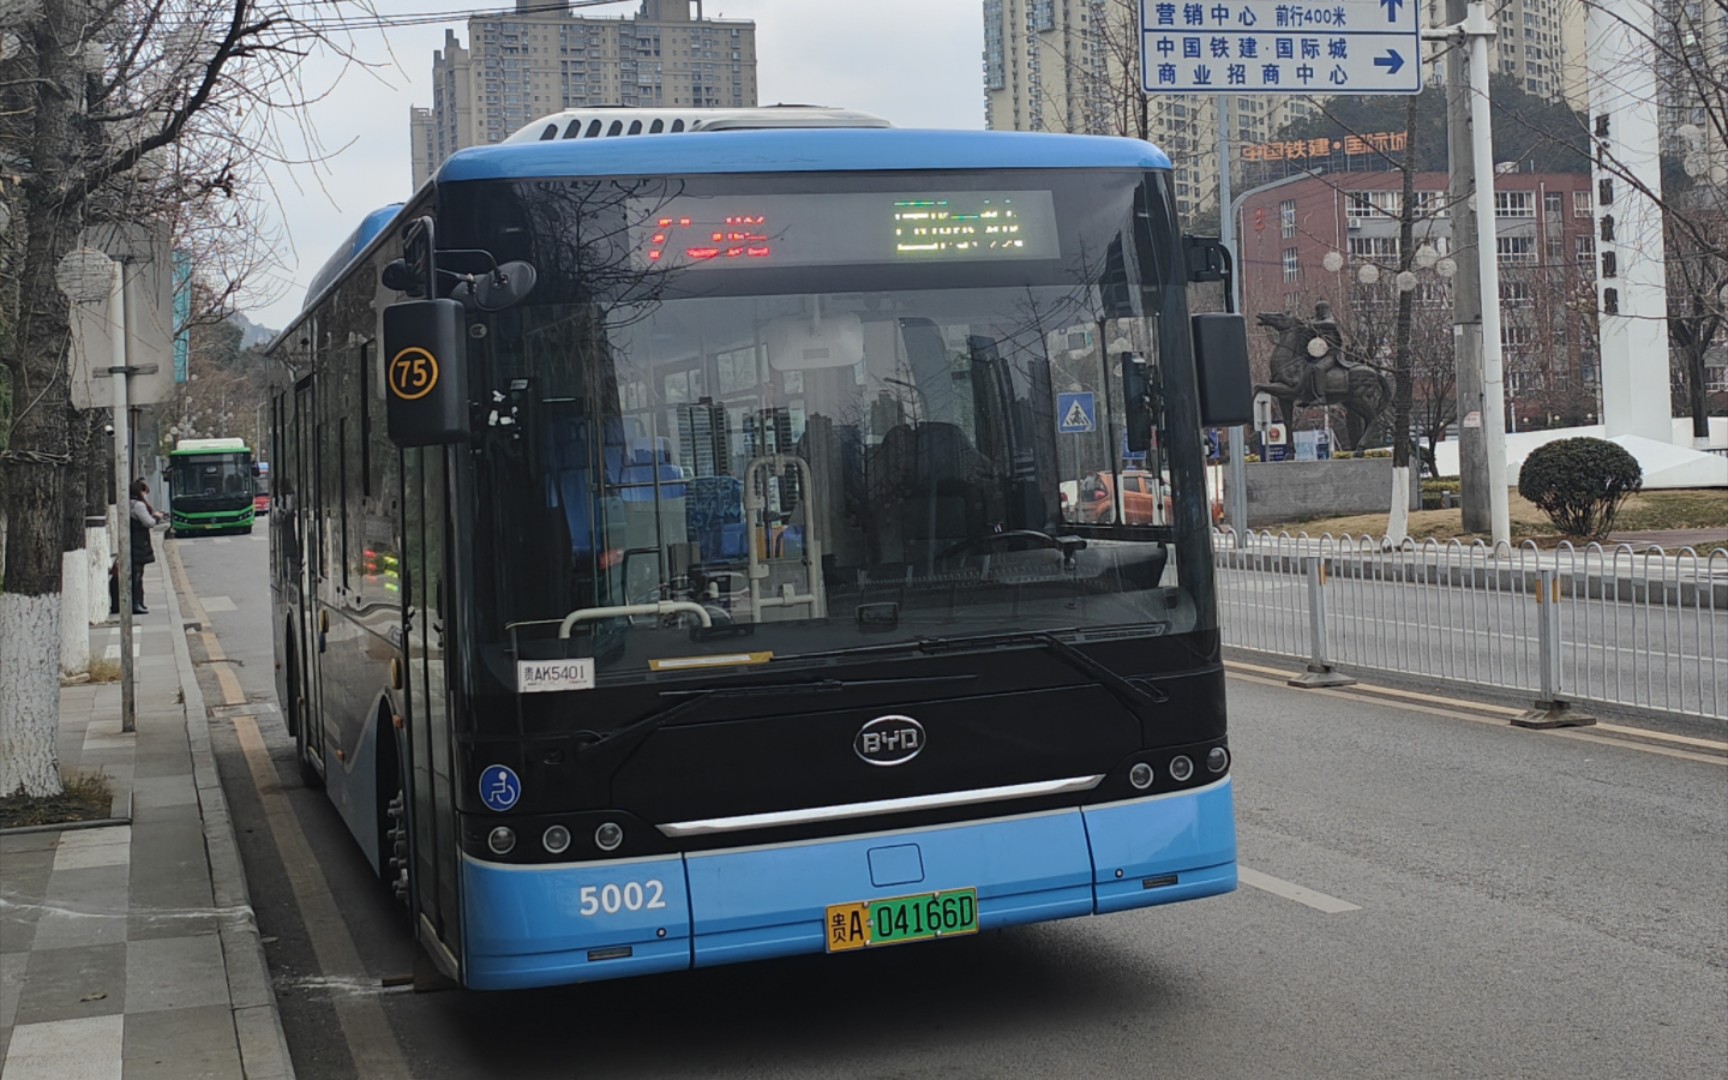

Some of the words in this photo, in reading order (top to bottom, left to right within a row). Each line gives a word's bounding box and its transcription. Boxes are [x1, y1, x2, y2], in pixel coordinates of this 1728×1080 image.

[1156, 3, 1257, 27] 营销中心
[1275, 5, 1346, 28] 前行400米
[1156, 36, 1348, 60] 中国铁建·国际城
[1157, 62, 1348, 86] 商业招商中心
[397, 358, 428, 388] 75
[863, 728, 918, 754] BYD
[580, 879, 666, 916] 5002
[876, 895, 974, 938] 04166D
